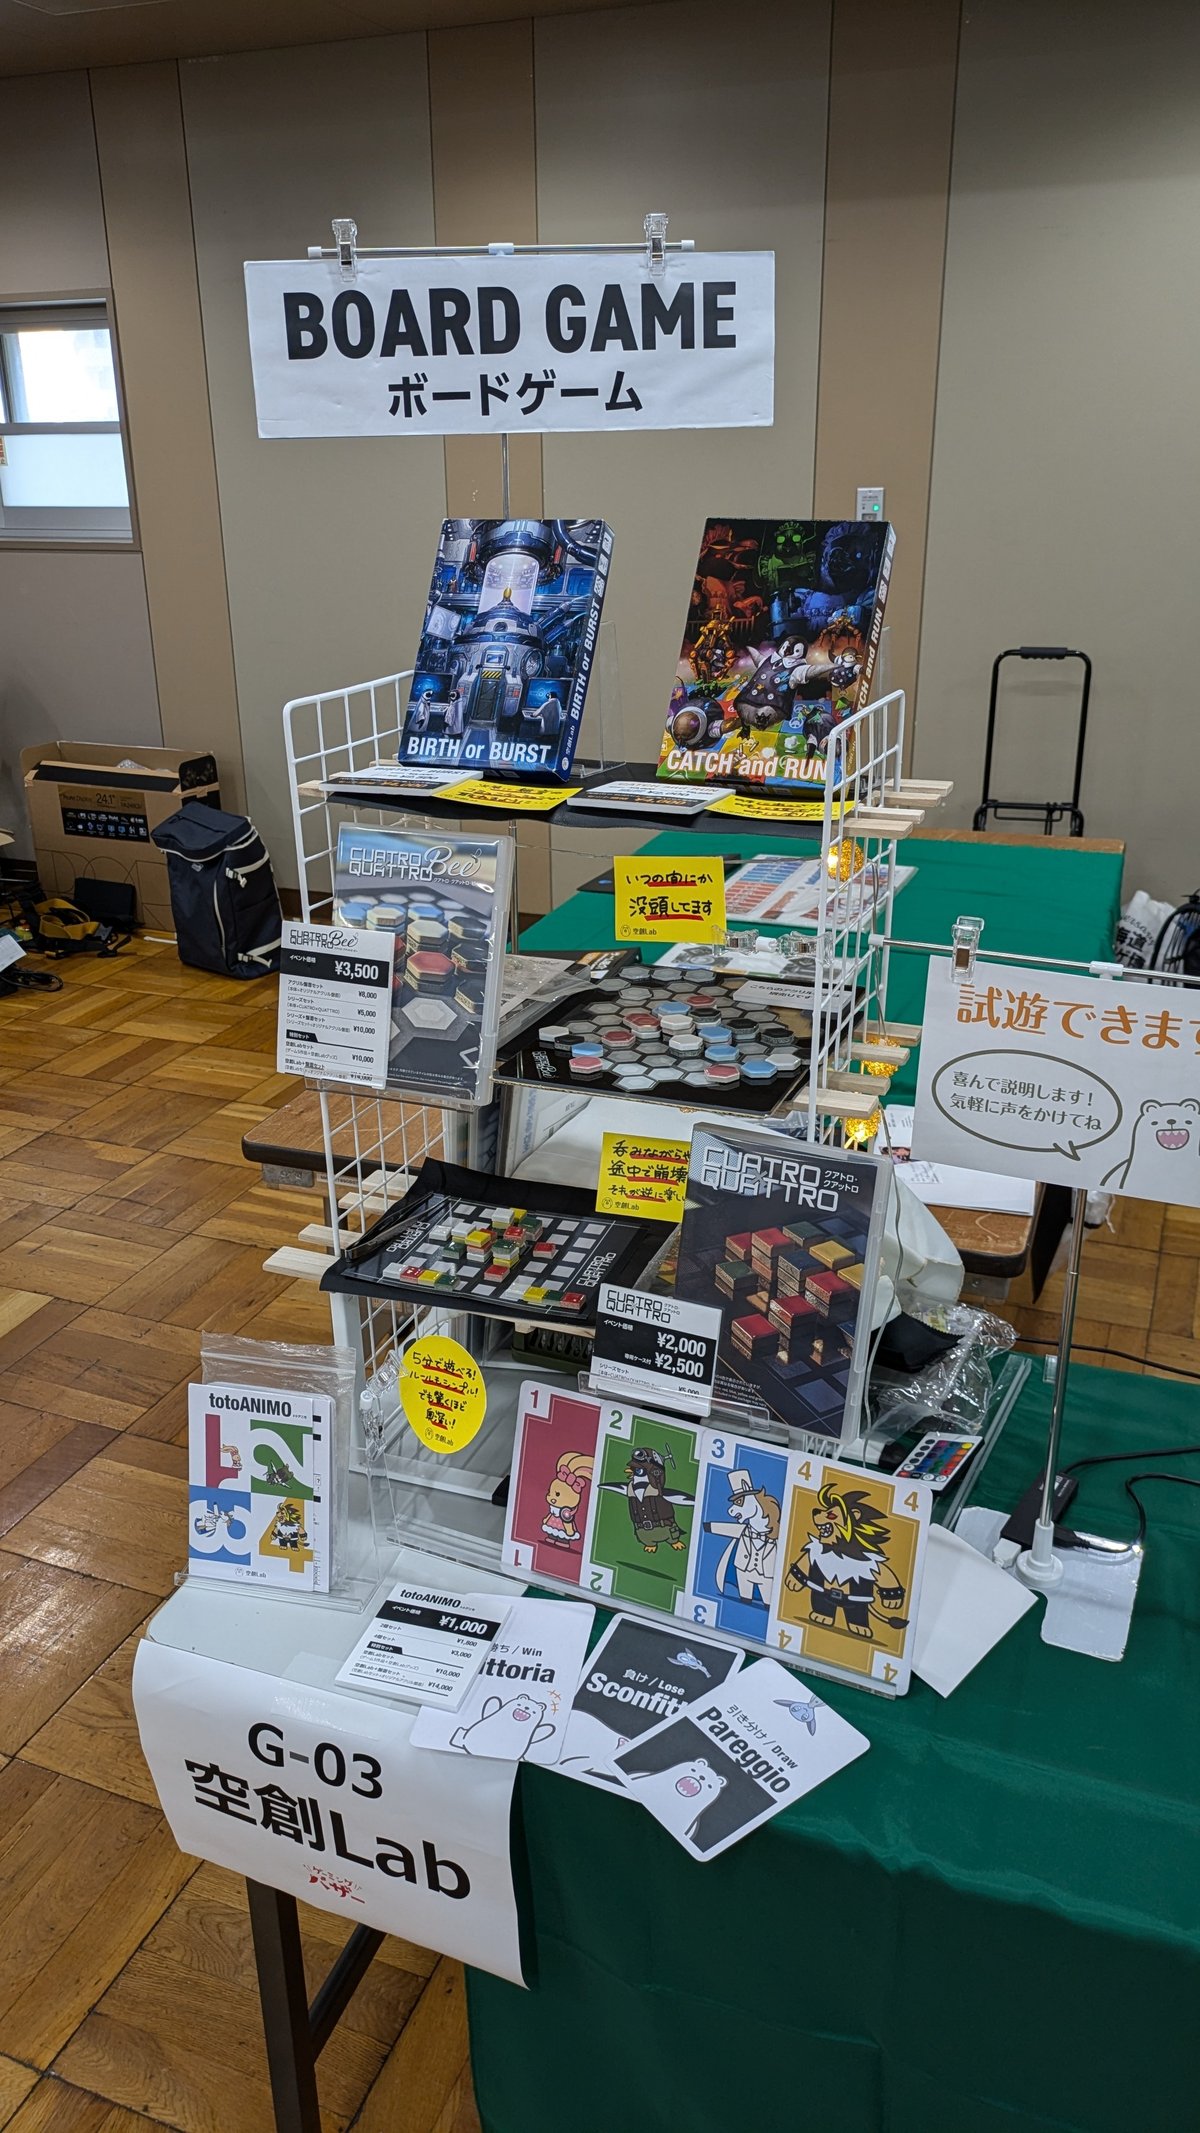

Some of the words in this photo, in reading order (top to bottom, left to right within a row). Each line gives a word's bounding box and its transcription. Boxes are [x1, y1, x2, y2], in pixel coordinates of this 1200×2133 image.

[283, 286, 521, 360] BOARD
[545, 281, 737, 354] GAME
[388, 369, 643, 418] ボードゲーム
[871, 607, 883, 645] RUN
[570, 672, 587, 721] BIRTH
[584, 598, 601, 651] BURST
[407, 736, 460, 757] BIRTH
[466, 745, 485, 759] or
[489, 743, 551, 763] BURST
[666, 750, 734, 774] CATCH
[738, 758, 778, 777] and
[784, 760, 827, 781] RUN
[348, 860, 433, 882] QUATTRO
[423, 845, 482, 877] Bee
[350, 847, 422, 867] CUATRO
[626, 869, 714, 885] いつの間にか
[628, 895, 713, 917] 没頭してます
[290, 929, 329, 941] CUATRO
[329, 930, 359, 948] Bee
[334, 960, 379, 980] ¥3,500
[358, 991, 377, 999] ¥8,000
[357, 1009, 377, 1017] ¥5,000
[957, 983, 1200, 1056] 試遊できま
[353, 1025, 375, 1035] ¥10,000
[351, 1054, 374, 1063] ¥10,000
[949, 1093, 1102, 1130] 気軽に声をかけてね
[607, 1159, 689, 1183] 途中で崩壊
[703, 1146, 821, 1187] CUATRO
[700, 1166, 839, 1212] QUATTRO
[823, 1179, 859, 1193] クアットロ
[607, 1289, 663, 1311] CUATRO
[606, 1301, 671, 1323] QUATTRO
[657, 1331, 707, 1358] ¥2,000
[654, 1352, 704, 1378] ¥2,500
[209, 1392, 291, 1417] totoANIMO
[530, 1391, 540, 1409] 1
[608, 1411, 624, 1431] 2
[711, 1438, 726, 1459] 3
[797, 1460, 813, 1481] 4
[903, 1490, 919, 1512] 4
[400, 1589, 461, 1608] totoANIMO
[439, 1615, 488, 1635] ¥1,000
[450, 1650, 472, 1658] ¥3,000
[522, 1647, 543, 1657] Win
[435, 1668, 461, 1678] ¥10,000
[478, 1658, 556, 1683] ittoria
[428, 1681, 453, 1692] ¥14,000
[622, 1668, 648, 1683] 負け
[658, 1679, 686, 1696] Lose
[586, 1672, 689, 1717] Sconfitt
[726, 1704, 767, 1739] 引き分け
[771, 1745, 799, 1769] Draw
[696, 1706, 790, 1793] Pareggio
[247, 1722, 384, 1800] G-03
[183, 1758, 472, 1900] 空創Lab
